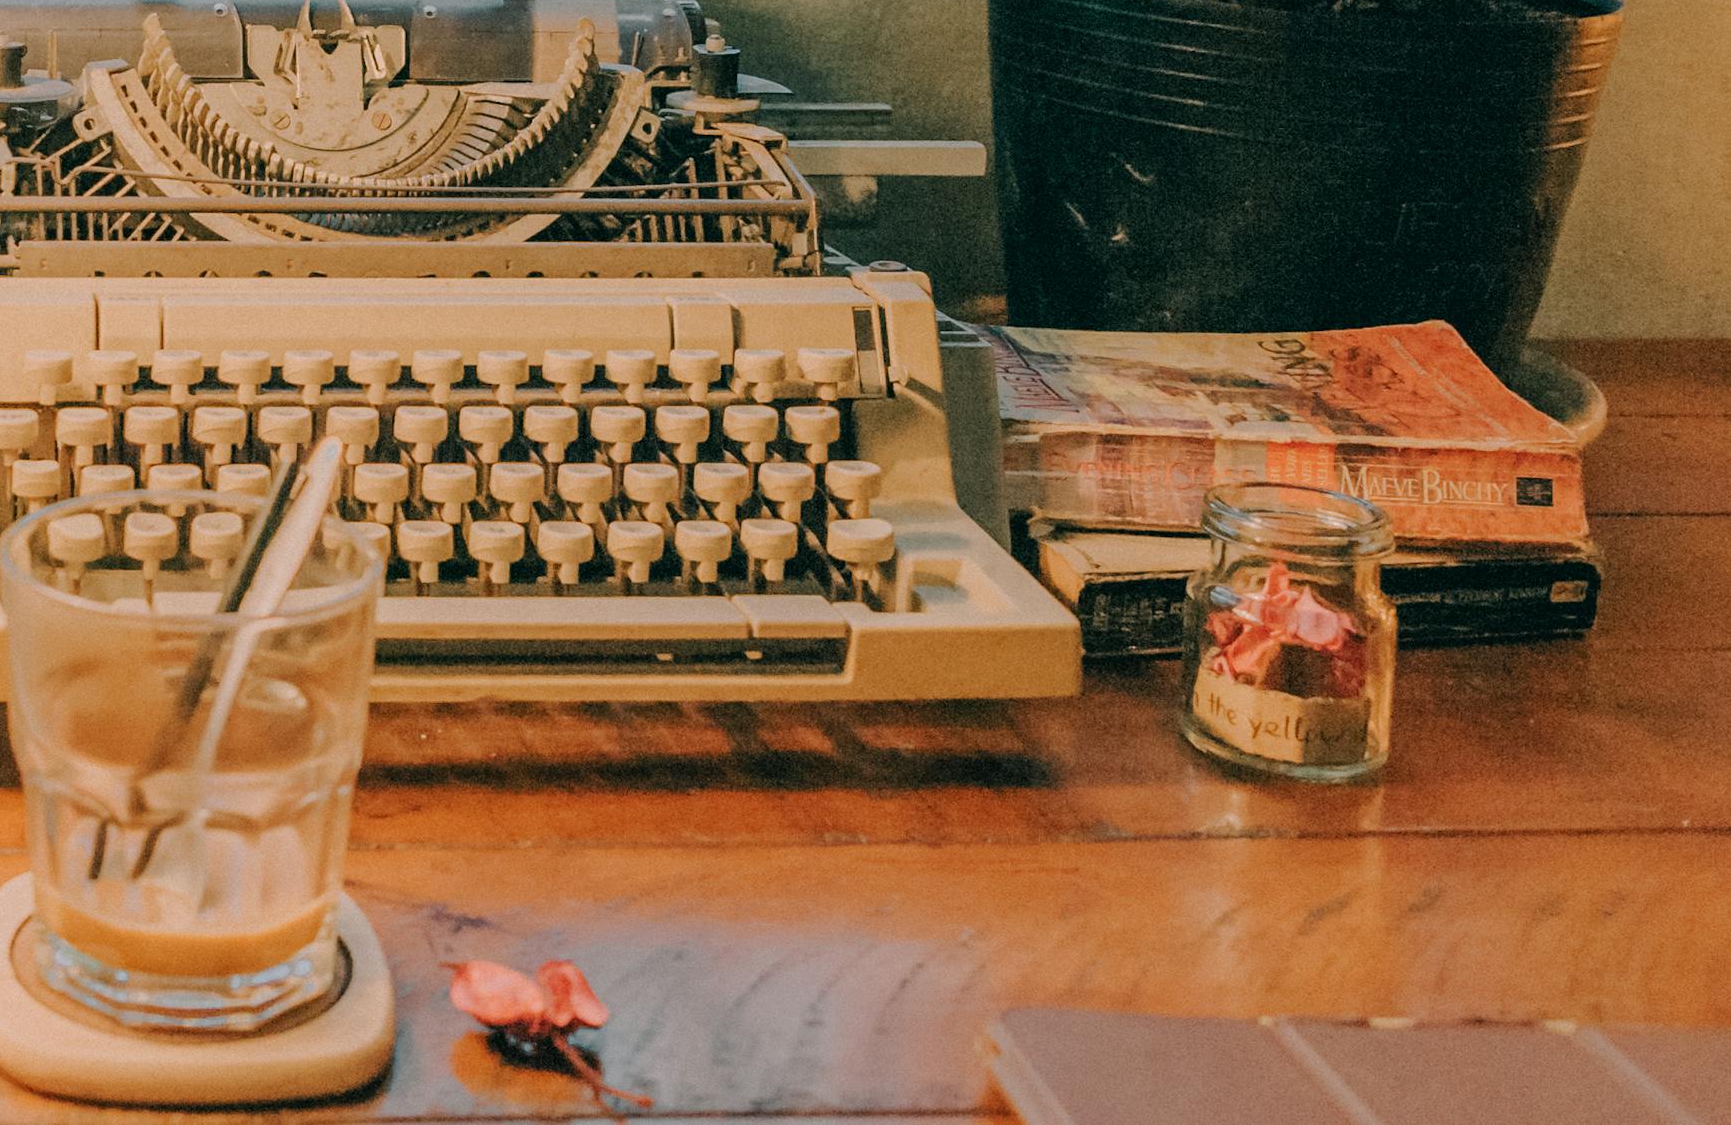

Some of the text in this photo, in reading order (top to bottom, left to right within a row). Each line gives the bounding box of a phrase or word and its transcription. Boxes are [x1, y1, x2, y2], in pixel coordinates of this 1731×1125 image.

[1340, 465, 1420, 501] MAEVE
[1422, 466, 1508, 505] BINCHY
[1208, 692, 1238, 725] the
